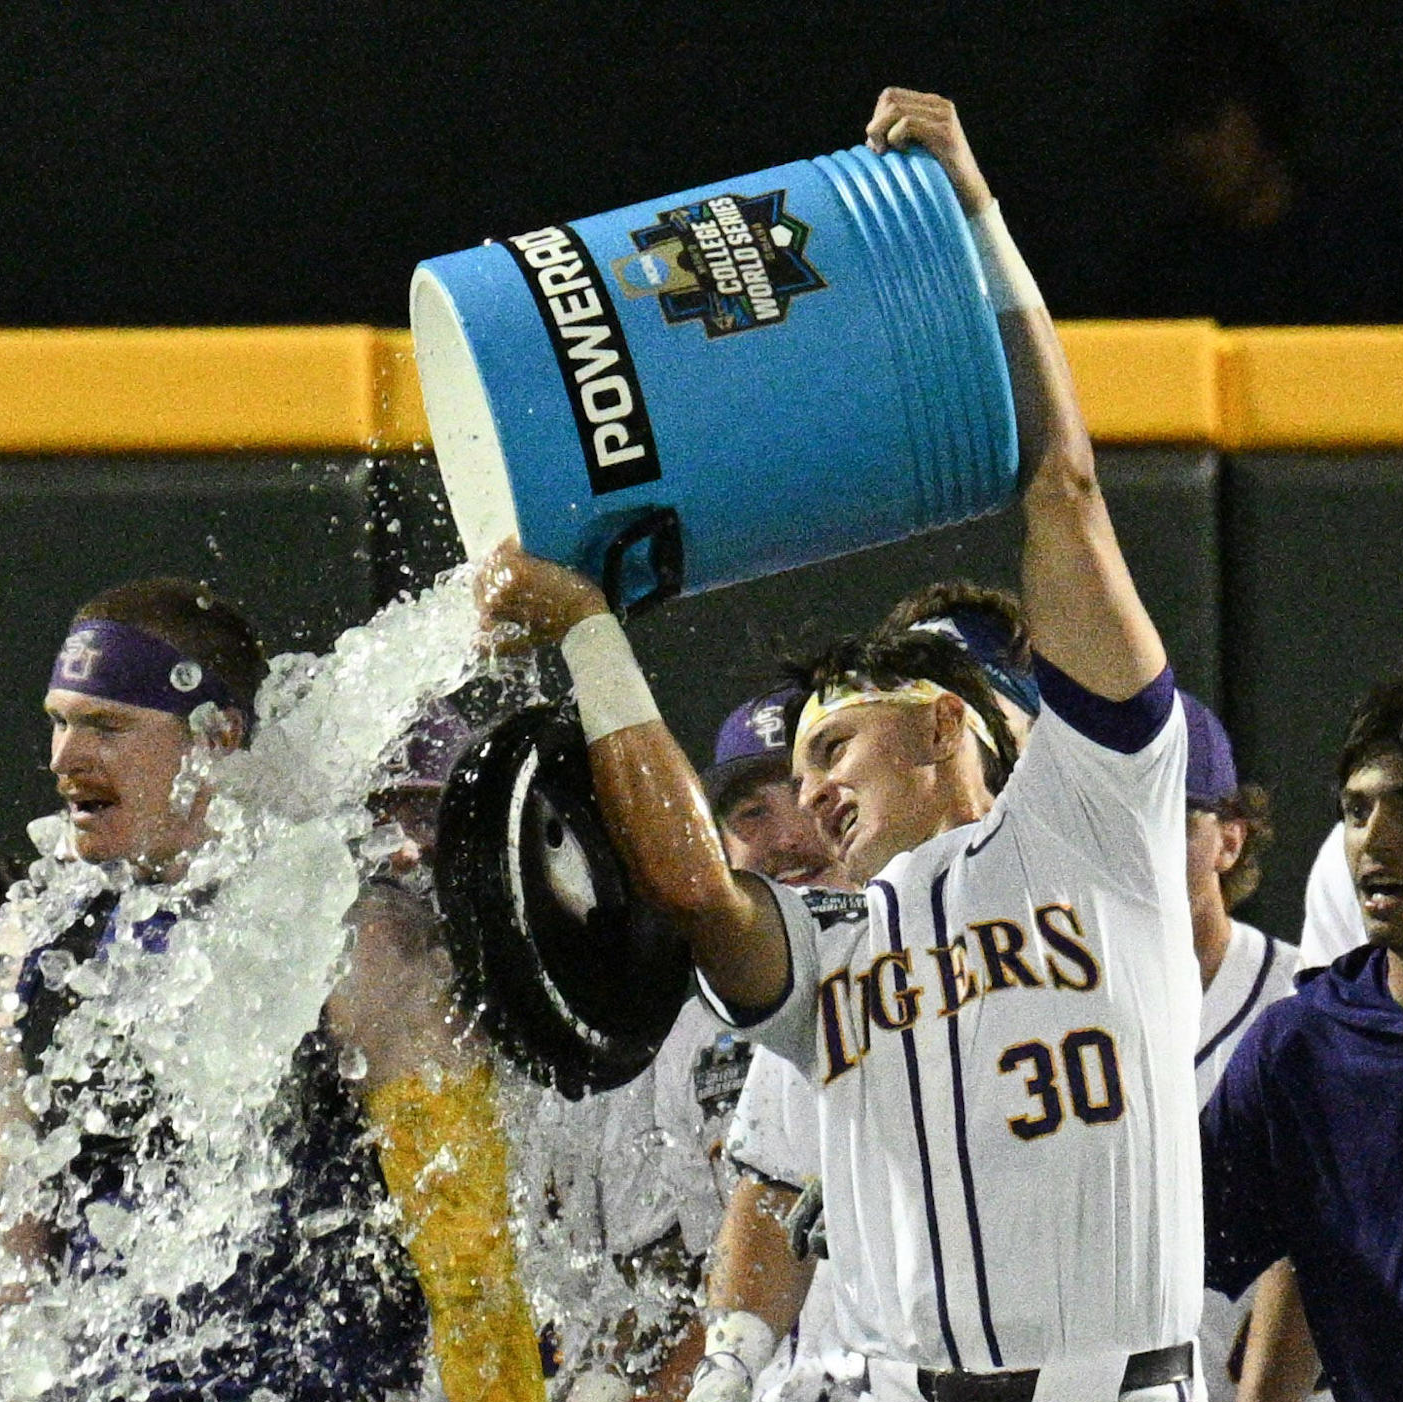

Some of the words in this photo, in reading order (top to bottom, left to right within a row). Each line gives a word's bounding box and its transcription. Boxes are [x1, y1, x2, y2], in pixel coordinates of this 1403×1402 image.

[690, 218, 743, 295] COLLEGE
[707, 197, 753, 245] SERIES
[732, 246, 781, 321] WORLD
[808, 902, 1101, 1088] TIGERS
[998, 1028, 1125, 1140] 30
